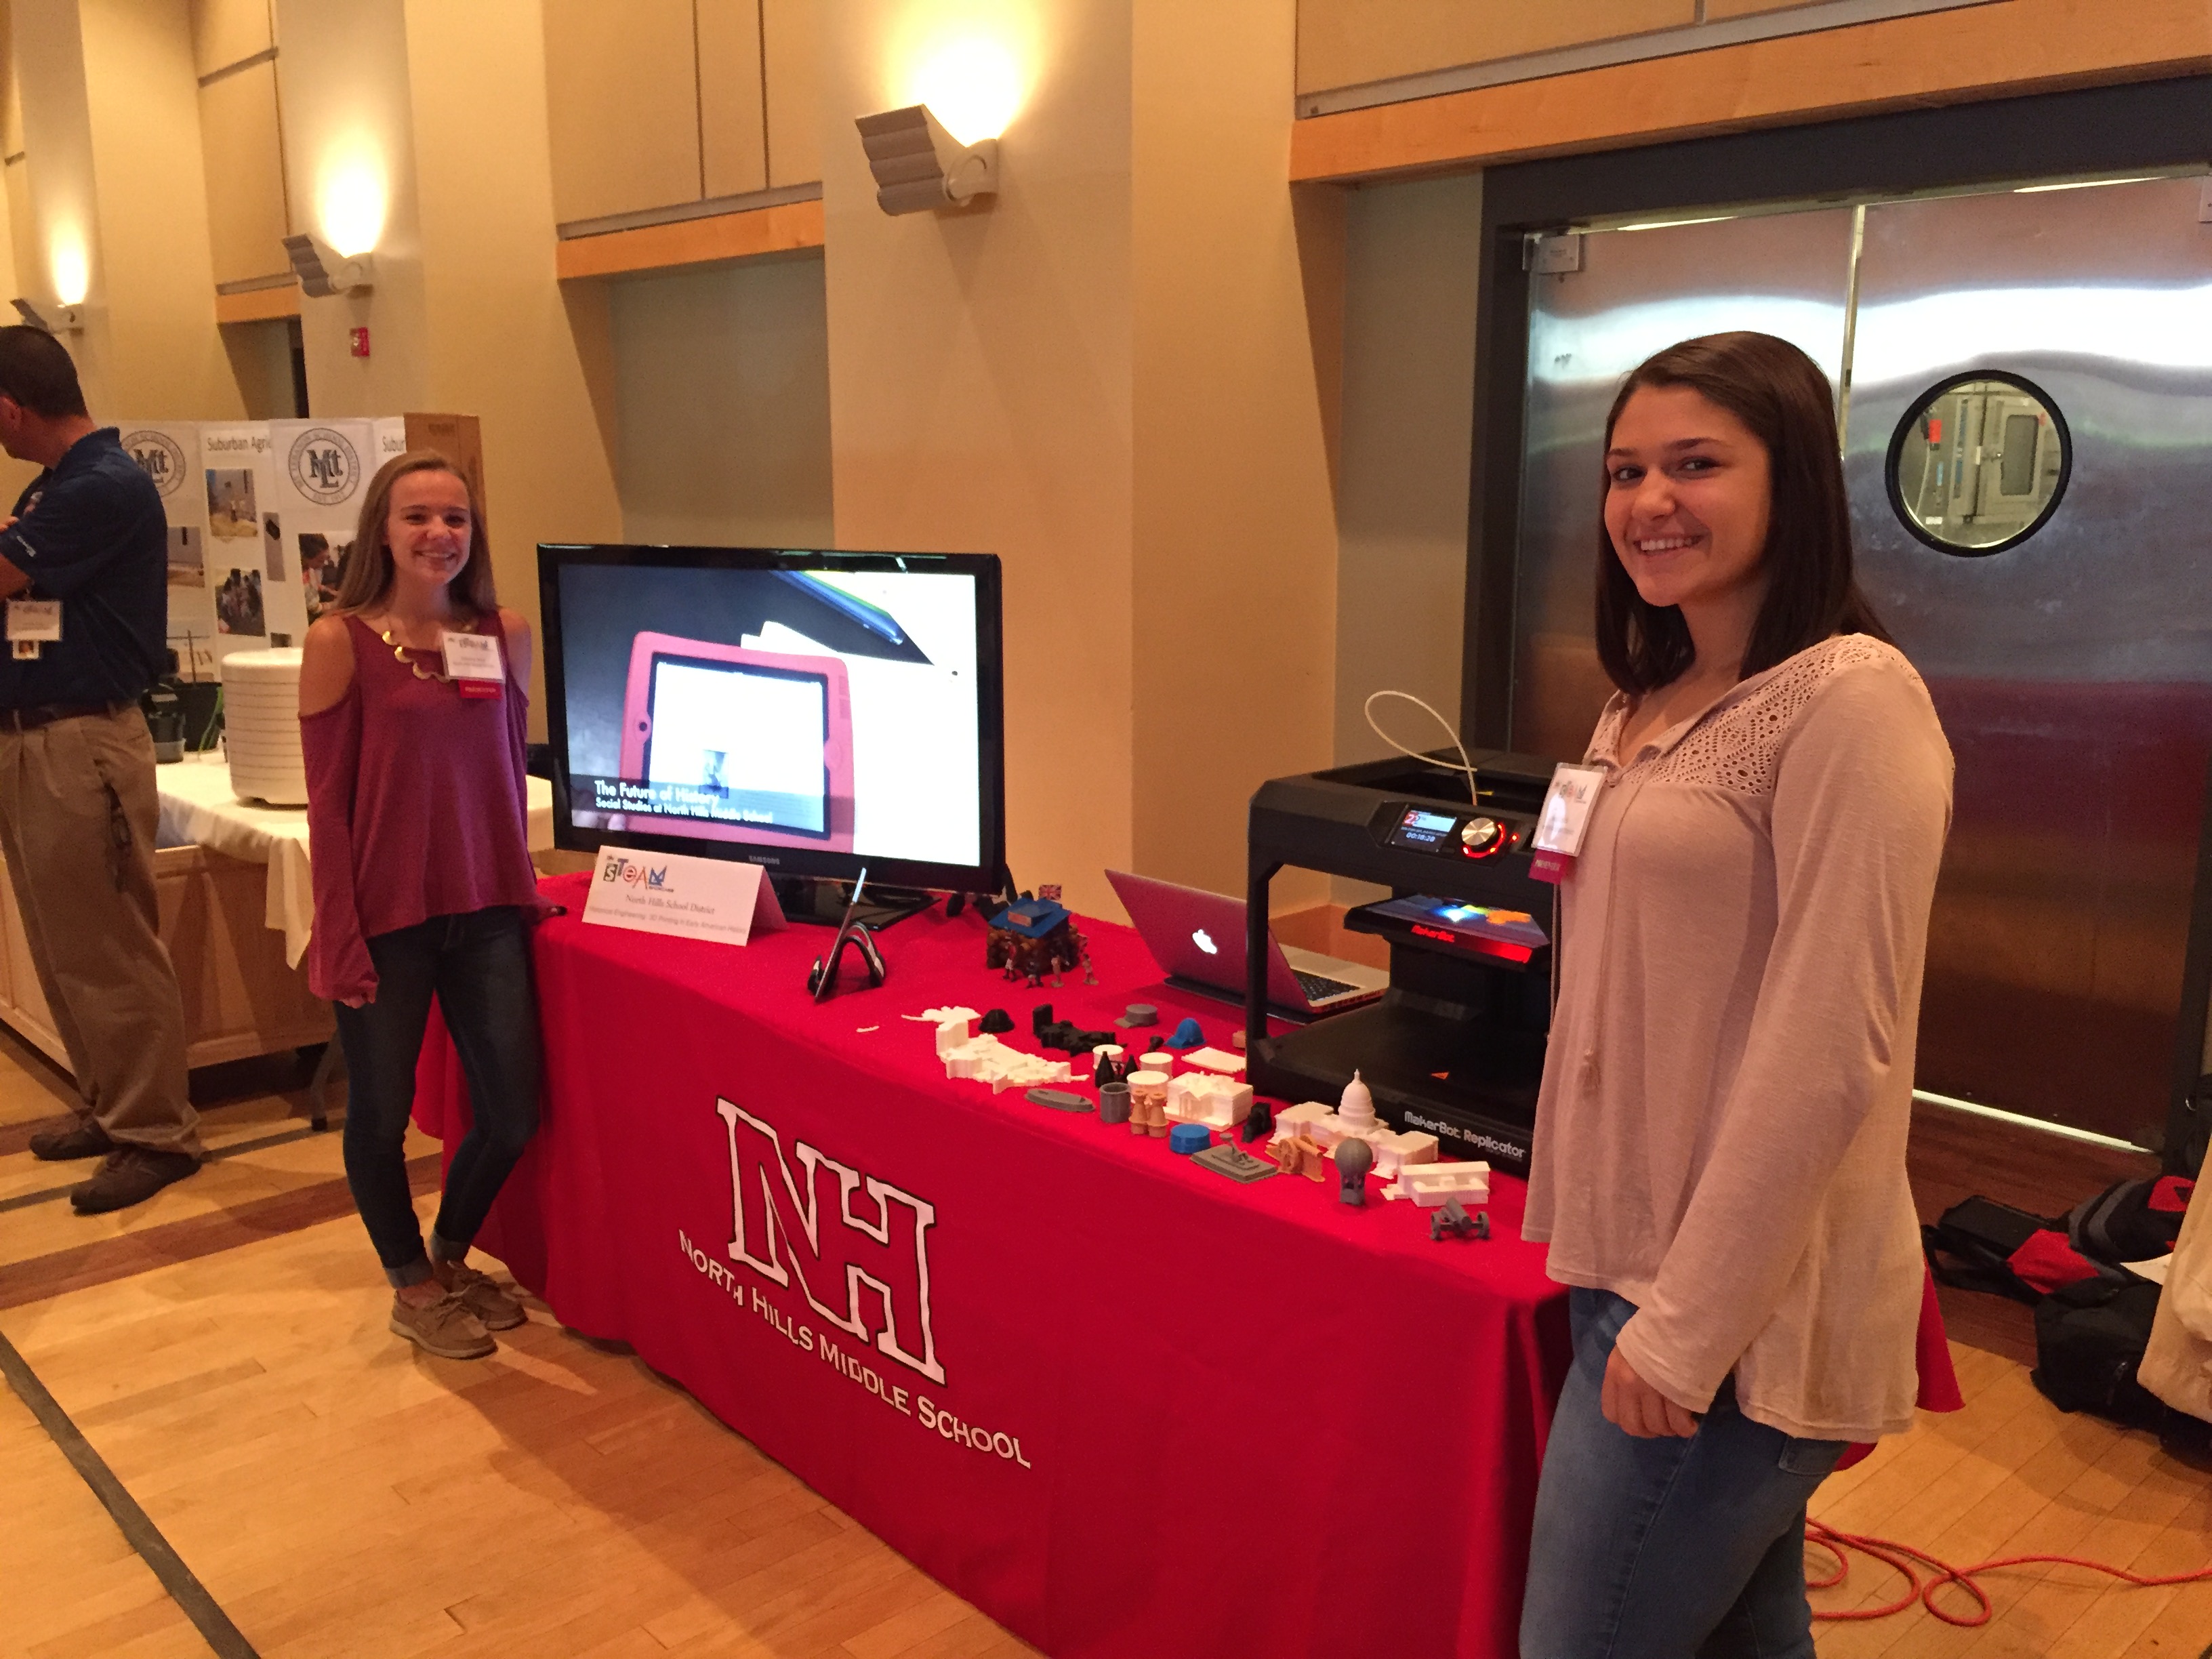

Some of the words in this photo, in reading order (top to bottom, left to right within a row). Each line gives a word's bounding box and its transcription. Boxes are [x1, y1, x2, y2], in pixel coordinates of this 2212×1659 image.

[207, 437, 249, 451] Suburban
[594, 779, 616, 796] The
[619, 782, 657, 800] Future
[659, 785, 673, 802] of
[675, 787, 720, 810] History
[596, 796, 621, 809] Social
[623, 798, 652, 813] Studies
[653, 804, 662, 813] at
[663, 803, 689, 816] North
[691, 804, 710, 818] Hills
[749, 855, 780, 865] SAMSUNG
[626, 894, 646, 904] North
[648, 897, 664, 907] Hills
[666, 899, 689, 911] School
[690, 902, 716, 914] District
[1411, 924, 1455, 943] MakerBot
[1404, 1110, 1461, 1139] MakerBot
[1463, 1129, 1526, 1159] Replicator
[716, 1095, 947, 1386] NH
